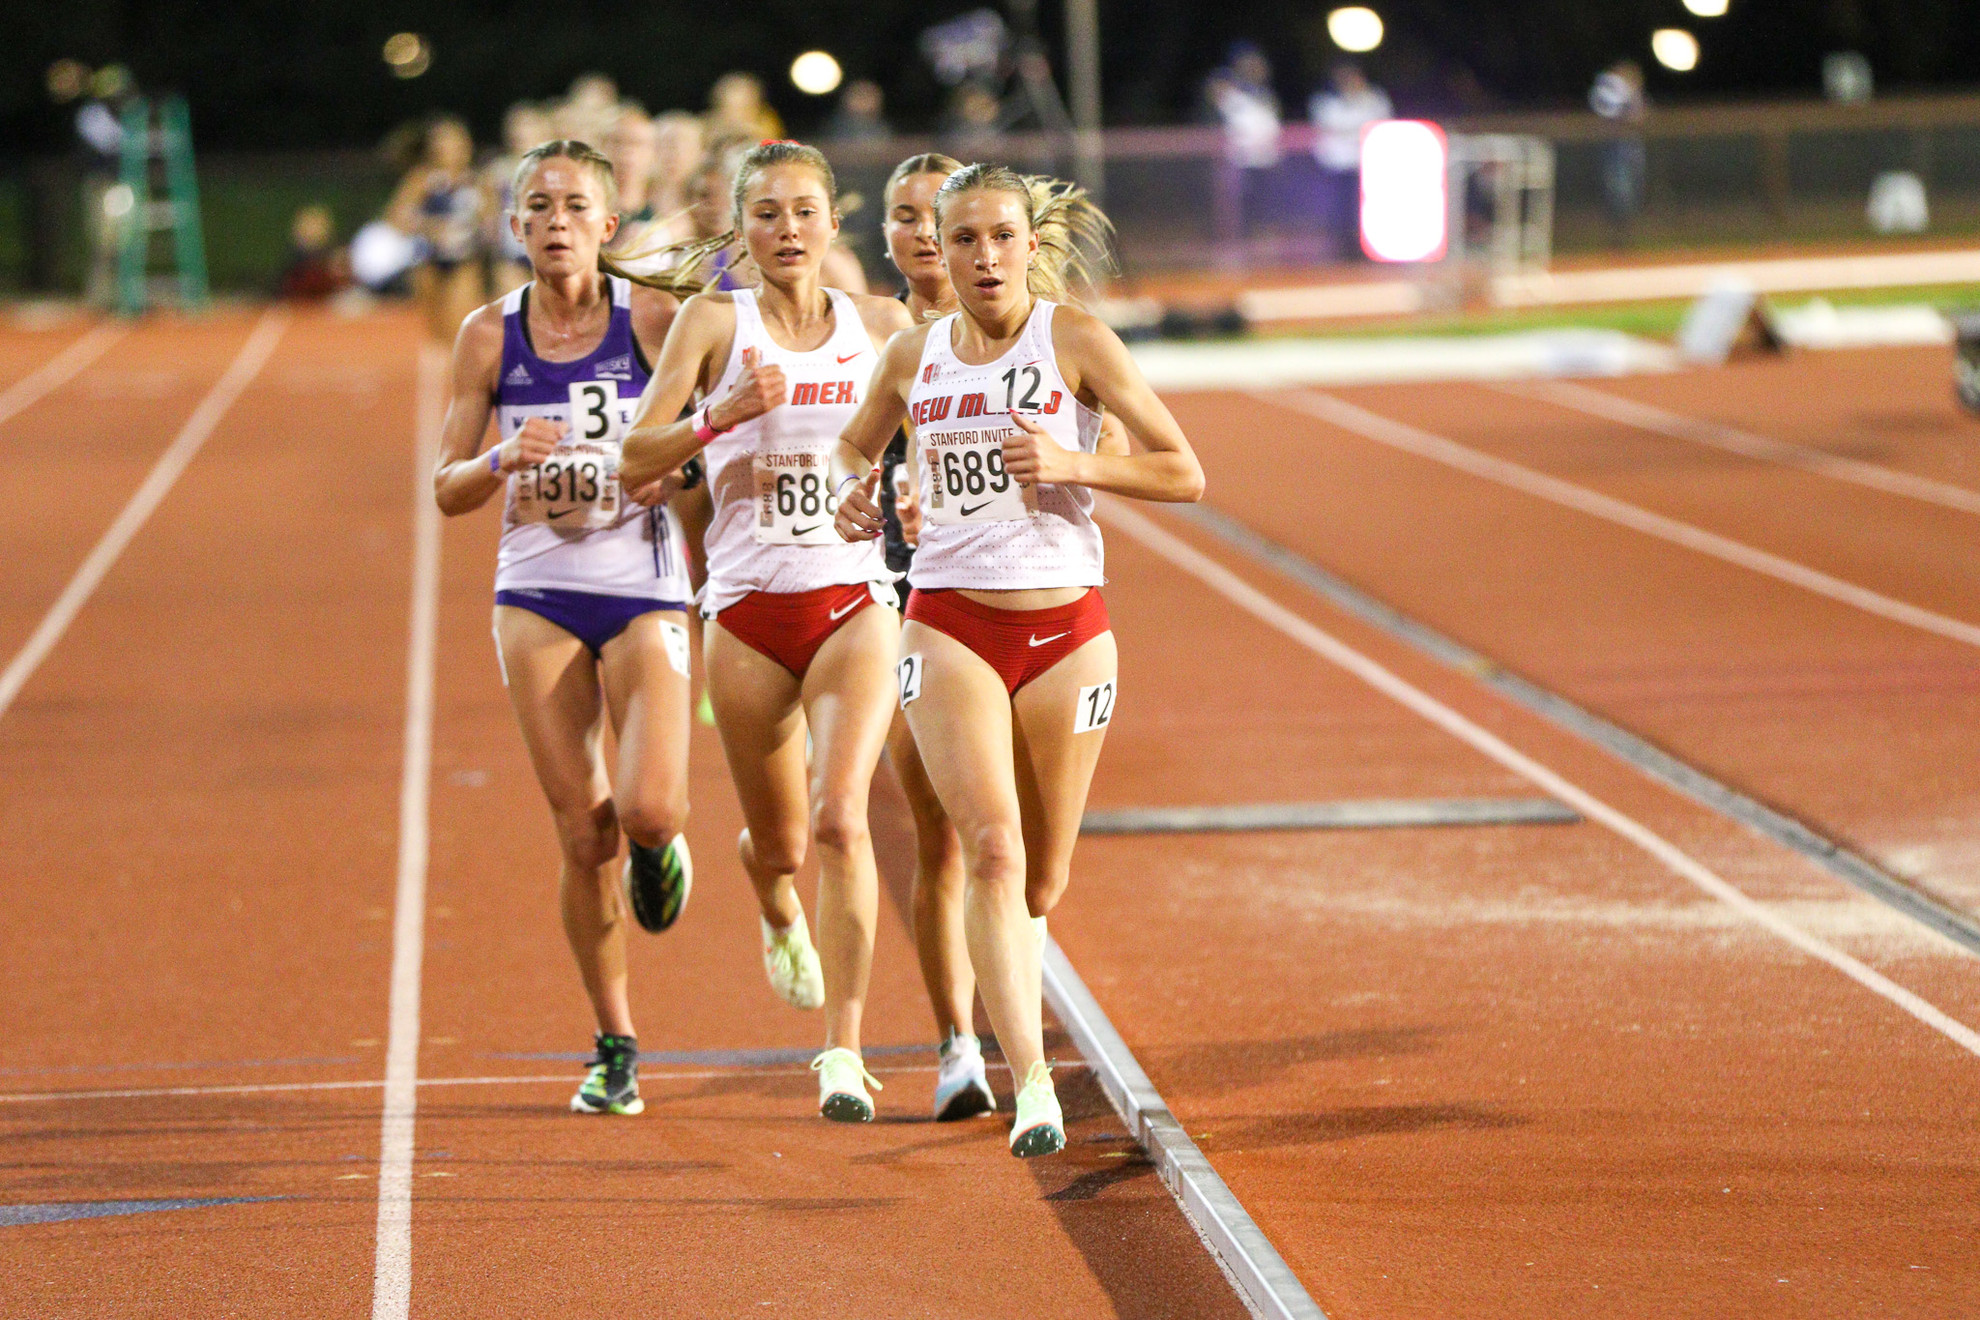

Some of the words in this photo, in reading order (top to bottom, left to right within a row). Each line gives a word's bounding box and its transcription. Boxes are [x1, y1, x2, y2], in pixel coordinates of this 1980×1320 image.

[1001, 366, 1041, 409] 12
[582, 386, 610, 439] 3
[912, 395, 953, 427] NEW
[930, 430, 979, 447] STANFORD
[981, 427, 1014, 445] INVITE
[532, 462, 599, 501] 1313
[766, 453, 820, 468] STANFORD
[943, 448, 1010, 497] 689
[898, 656, 915, 702] 2
[1088, 683, 1112, 728] 12
